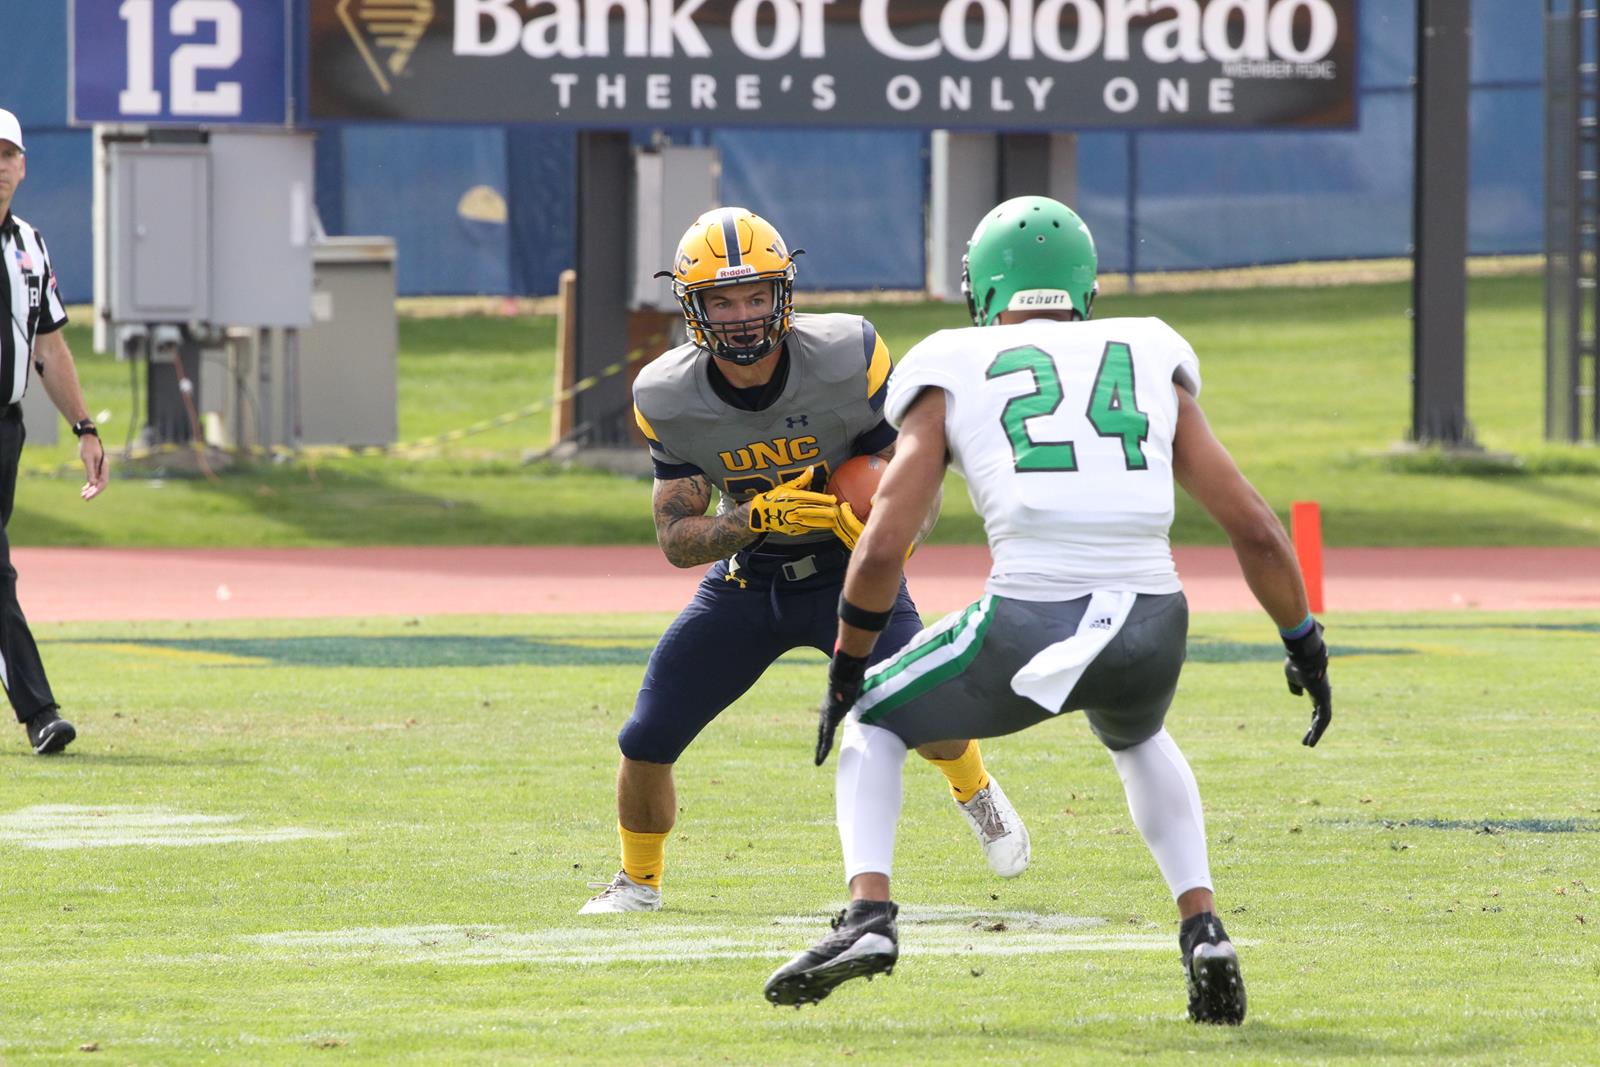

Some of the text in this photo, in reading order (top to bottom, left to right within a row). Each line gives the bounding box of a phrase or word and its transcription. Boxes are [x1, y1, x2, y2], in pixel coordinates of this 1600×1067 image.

[453, 0, 712, 59] Bank
[859, 0, 1338, 62] Colorado
[119, 0, 242, 117] 12
[1221, 61, 1293, 79] MEMBER
[551, 74, 1235, 113] THERE'S ONLY ONE
[720, 267, 752, 278] Riddell
[985, 340, 1149, 473] 24
[718, 434, 820, 472] UNC
